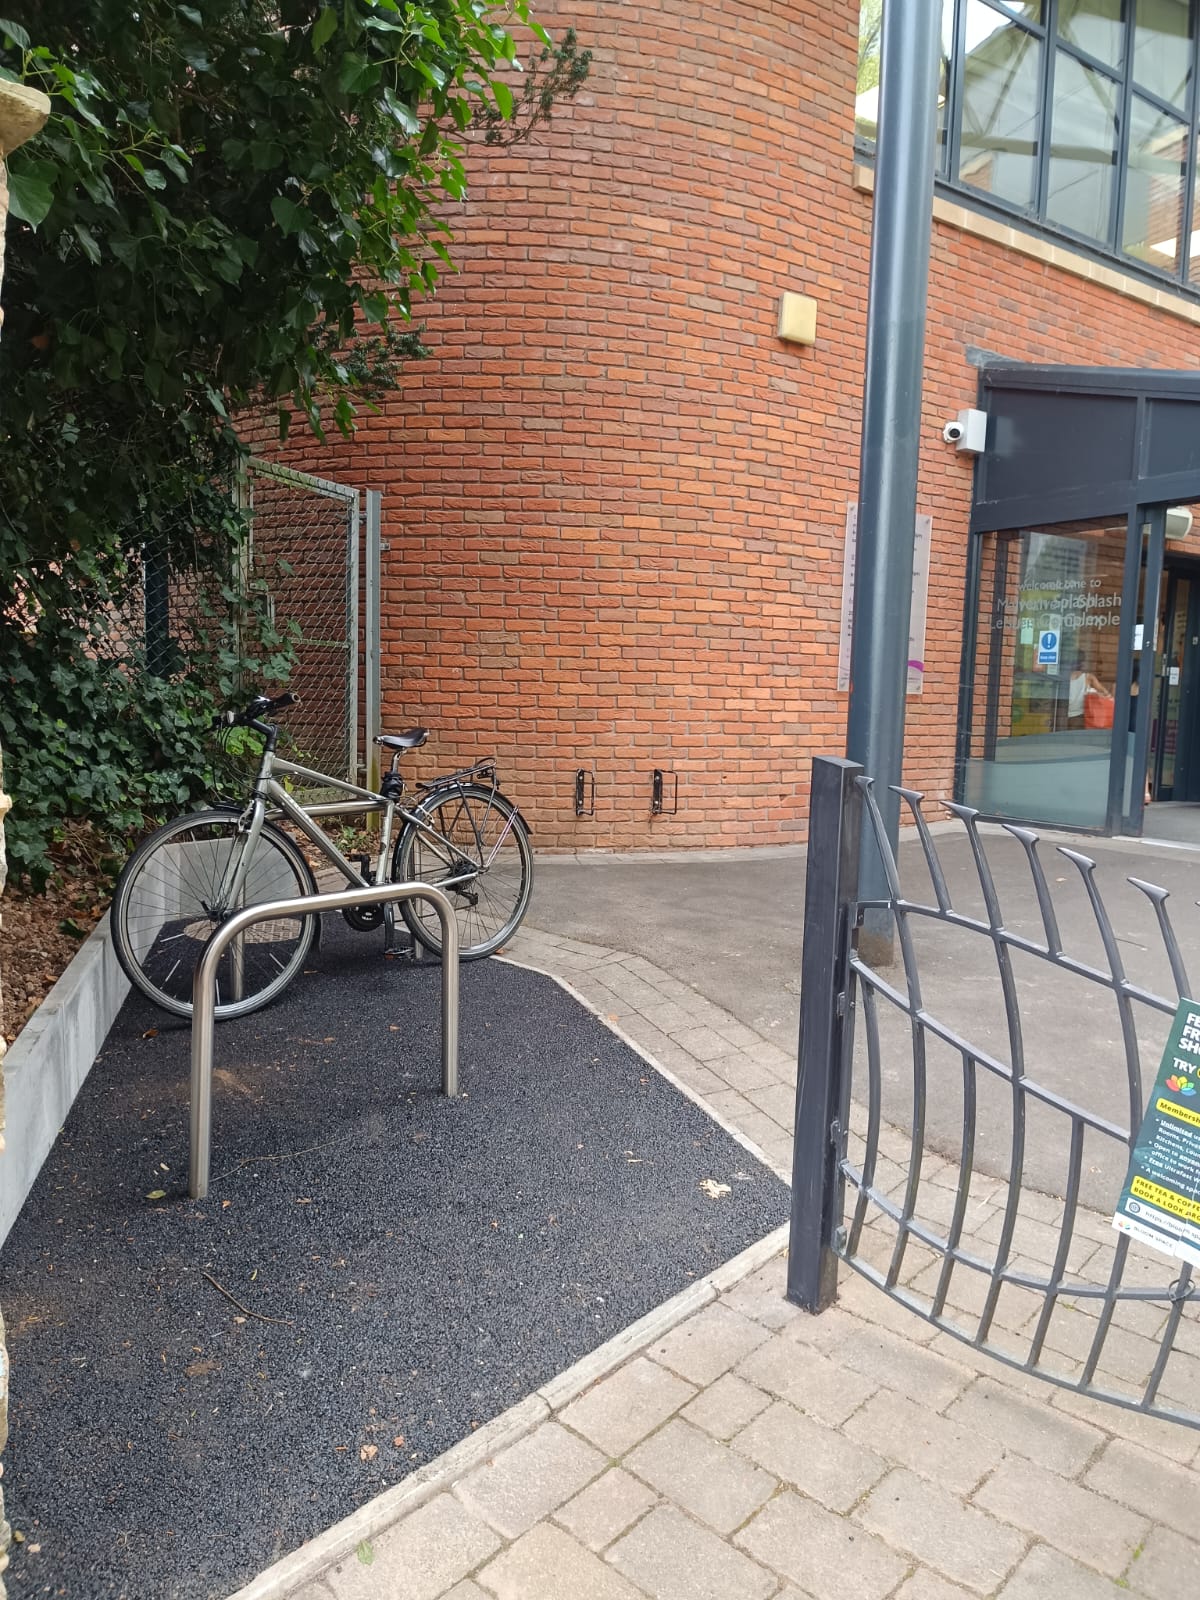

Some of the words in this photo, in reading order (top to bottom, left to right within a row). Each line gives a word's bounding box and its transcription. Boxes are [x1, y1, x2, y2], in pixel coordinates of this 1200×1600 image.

[1182, 1024, 1200, 1042] FR
[1173, 1057, 1197, 1074] TRY
[1160, 1120, 1193, 1138] Unlimited
[1153, 1142, 1171, 1154] Open
[1151, 1150, 1169, 1161] office
[1170, 1157, 1177, 1165] to
[1178, 1162, 1194, 1172] work
[1151, 1170, 1186, 1190] welcoming
[1164, 1164, 1193, 1181] Ultrafast
[1136, 1179, 1153, 1191] FREE
[1155, 1187, 1168, 1197] TEA
[1134, 1186, 1154, 1200] BOOK
[1163, 1200, 1185, 1213] LOOK
